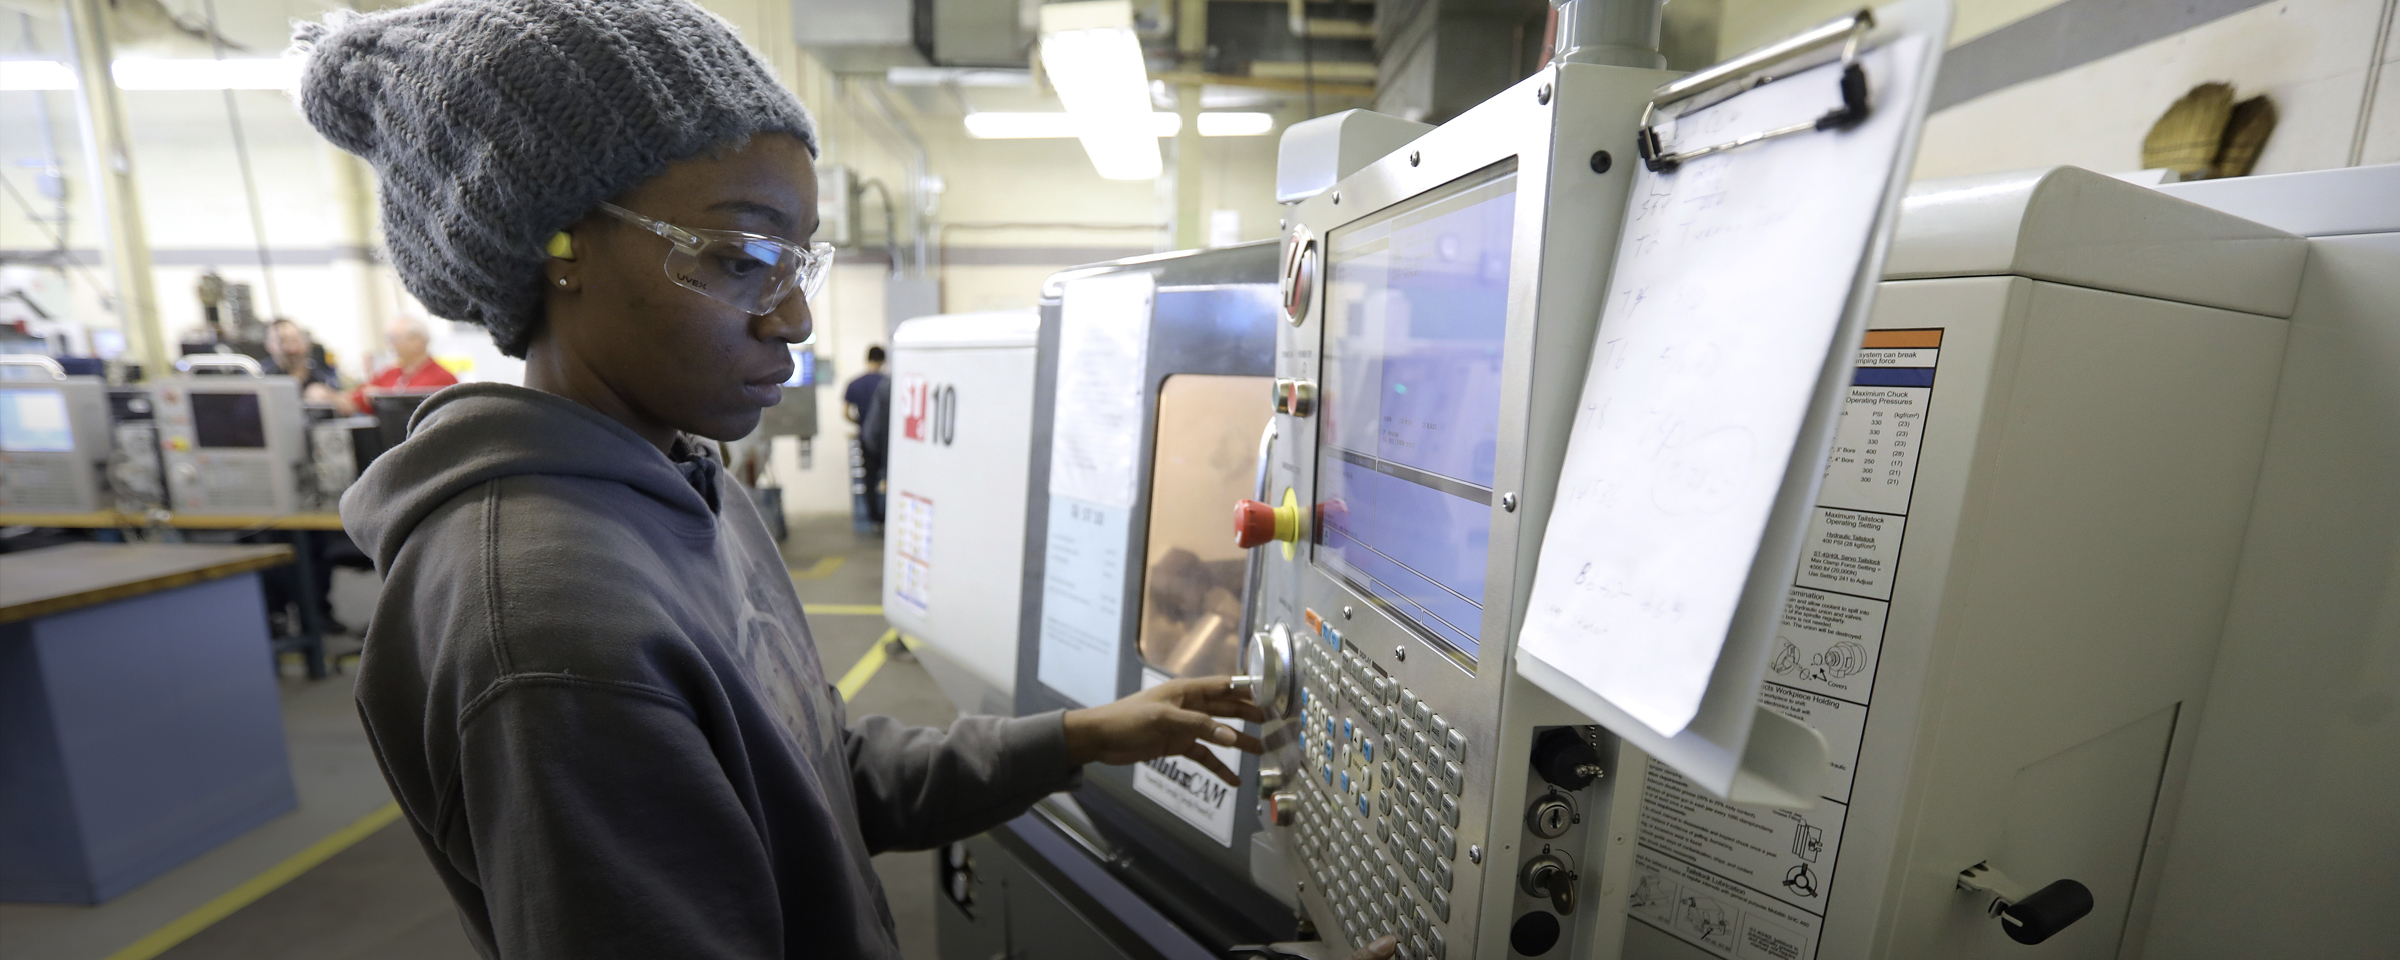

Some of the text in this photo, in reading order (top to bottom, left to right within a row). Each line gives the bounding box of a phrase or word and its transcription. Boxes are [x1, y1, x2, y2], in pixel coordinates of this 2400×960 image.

[676, 272, 707, 290] UVEX
[932, 384, 956, 446] 10
[1825, 511, 1884, 523] Maximum Tailstock
[1826, 518, 1881, 531] Operating Setting
[1852, 534, 1875, 543] Tailstock
[1858, 557, 1880, 565] Tailstock
[1827, 681, 1847, 690] Covers
[1776, 687, 1811, 700] Workpiece
[1813, 696, 1840, 709] Holding
[1686, 866, 1746, 896] Tailstock Lubrication
